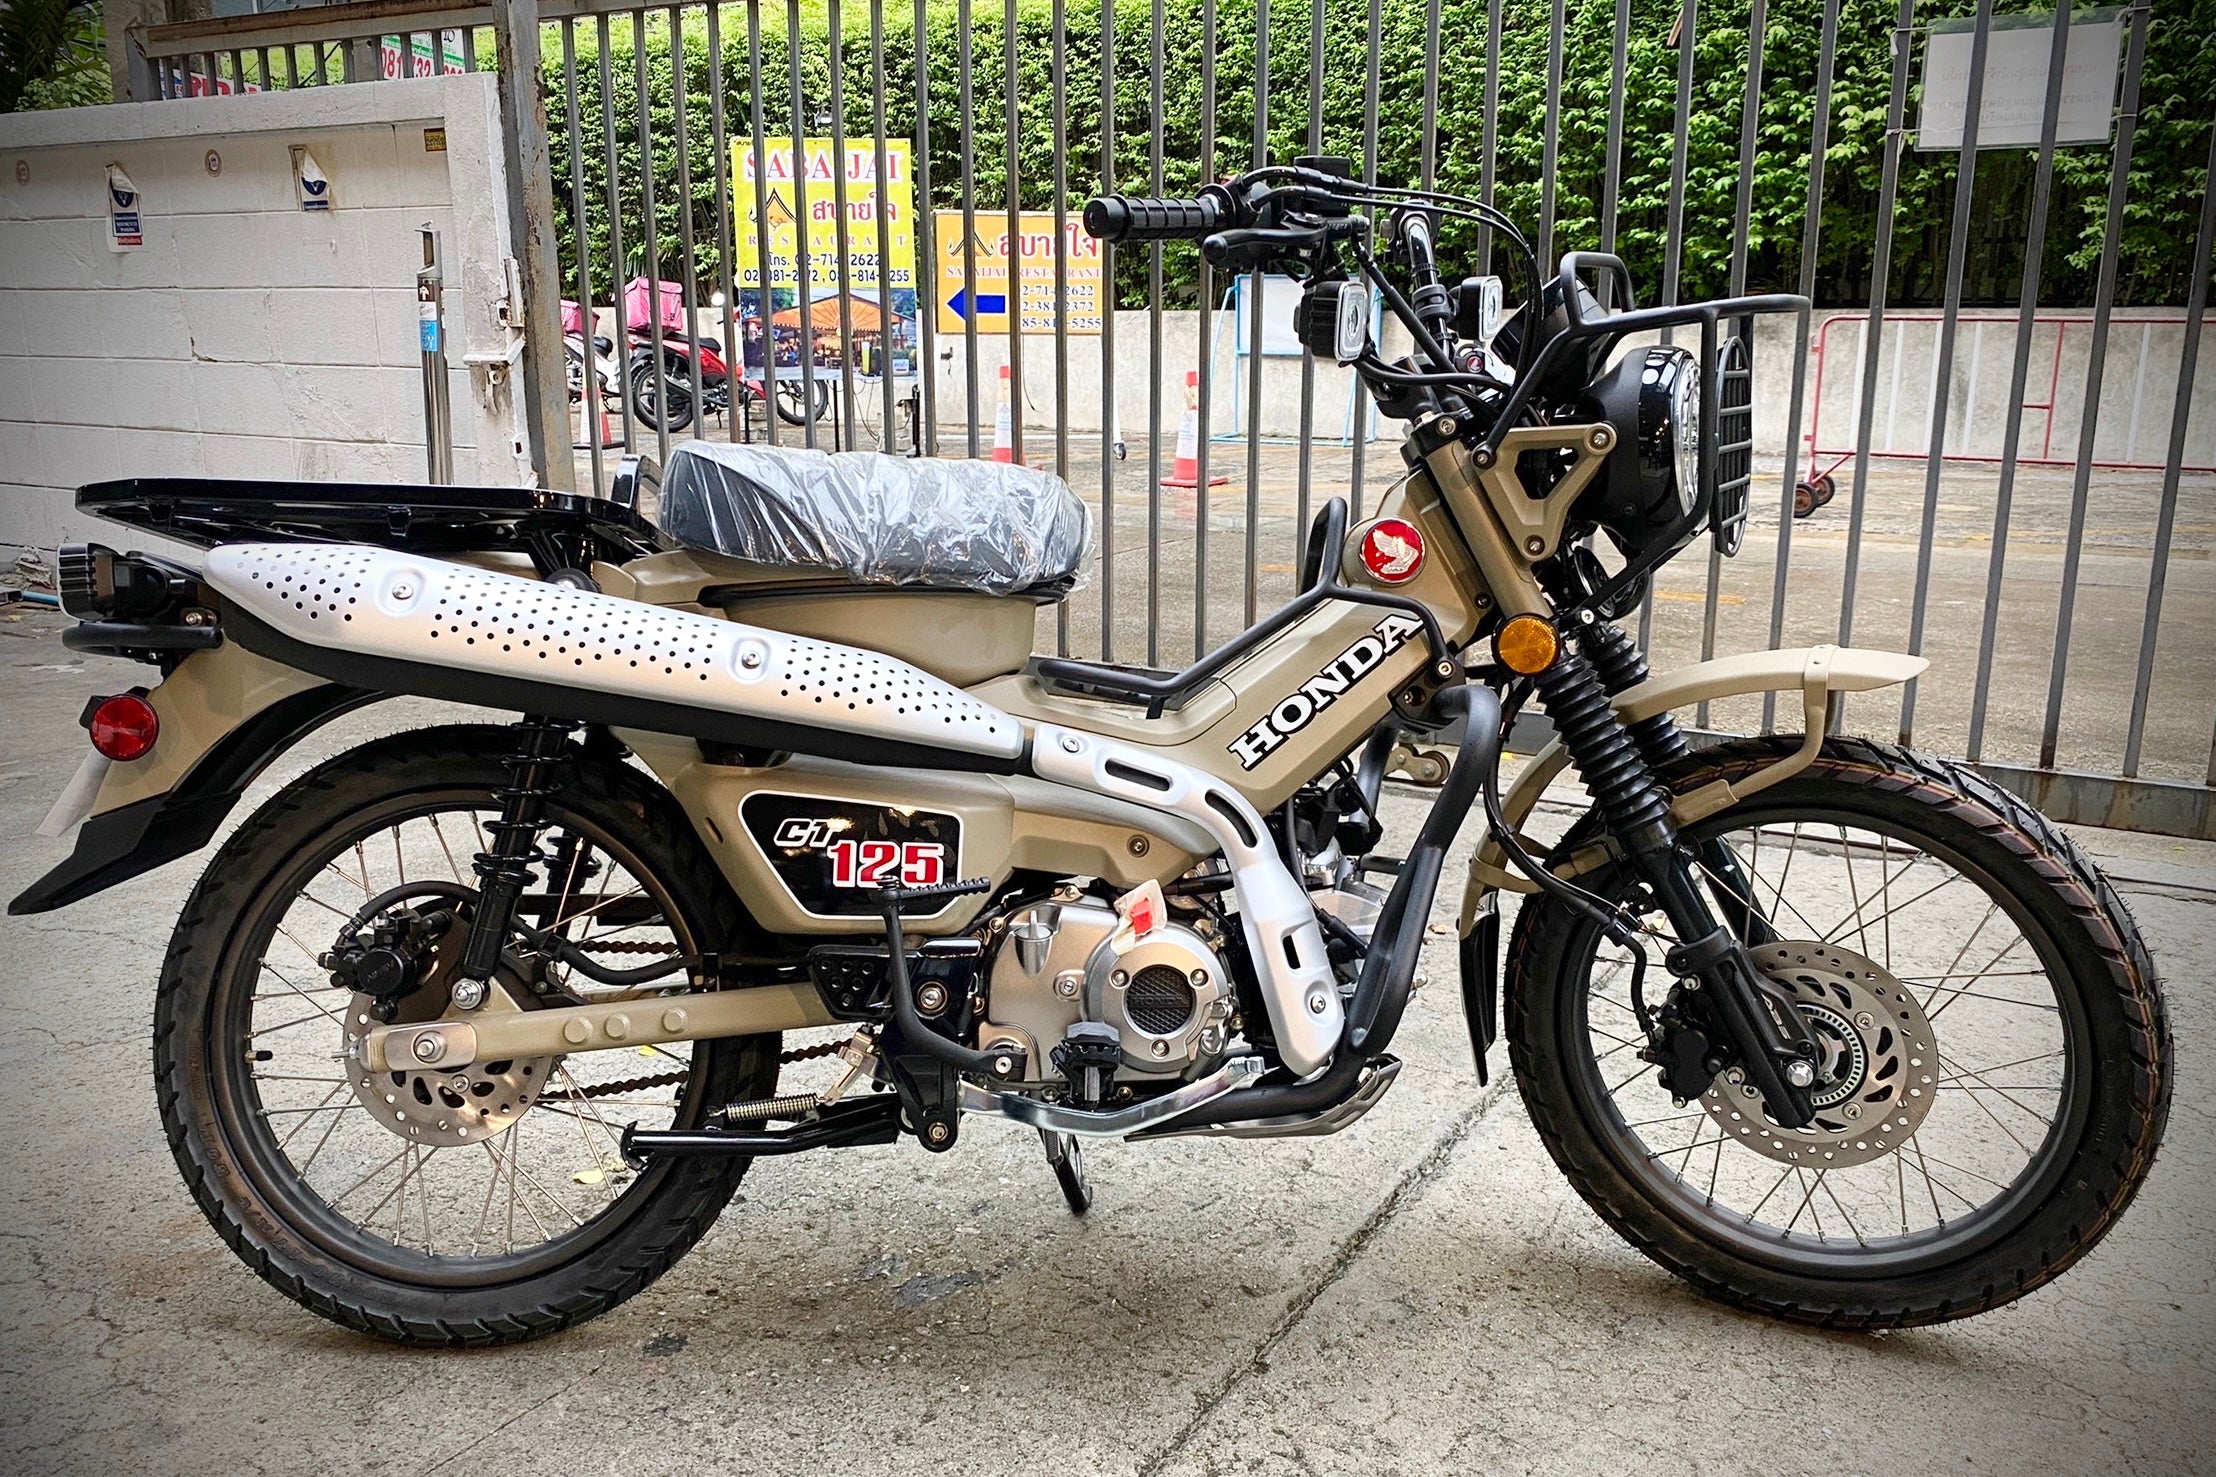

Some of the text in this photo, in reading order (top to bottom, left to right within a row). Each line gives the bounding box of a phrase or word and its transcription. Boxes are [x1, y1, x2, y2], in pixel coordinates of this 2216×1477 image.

[748, 235, 905, 246] RESAURAT
[999, 223, 1098, 258] สบาใจ
[947, 267, 1101, 278] SAAIJAI RESTARANT
[1226, 613, 1425, 772] HONDA
[773, 818, 840, 848] CT
[827, 839, 945, 889] 125
